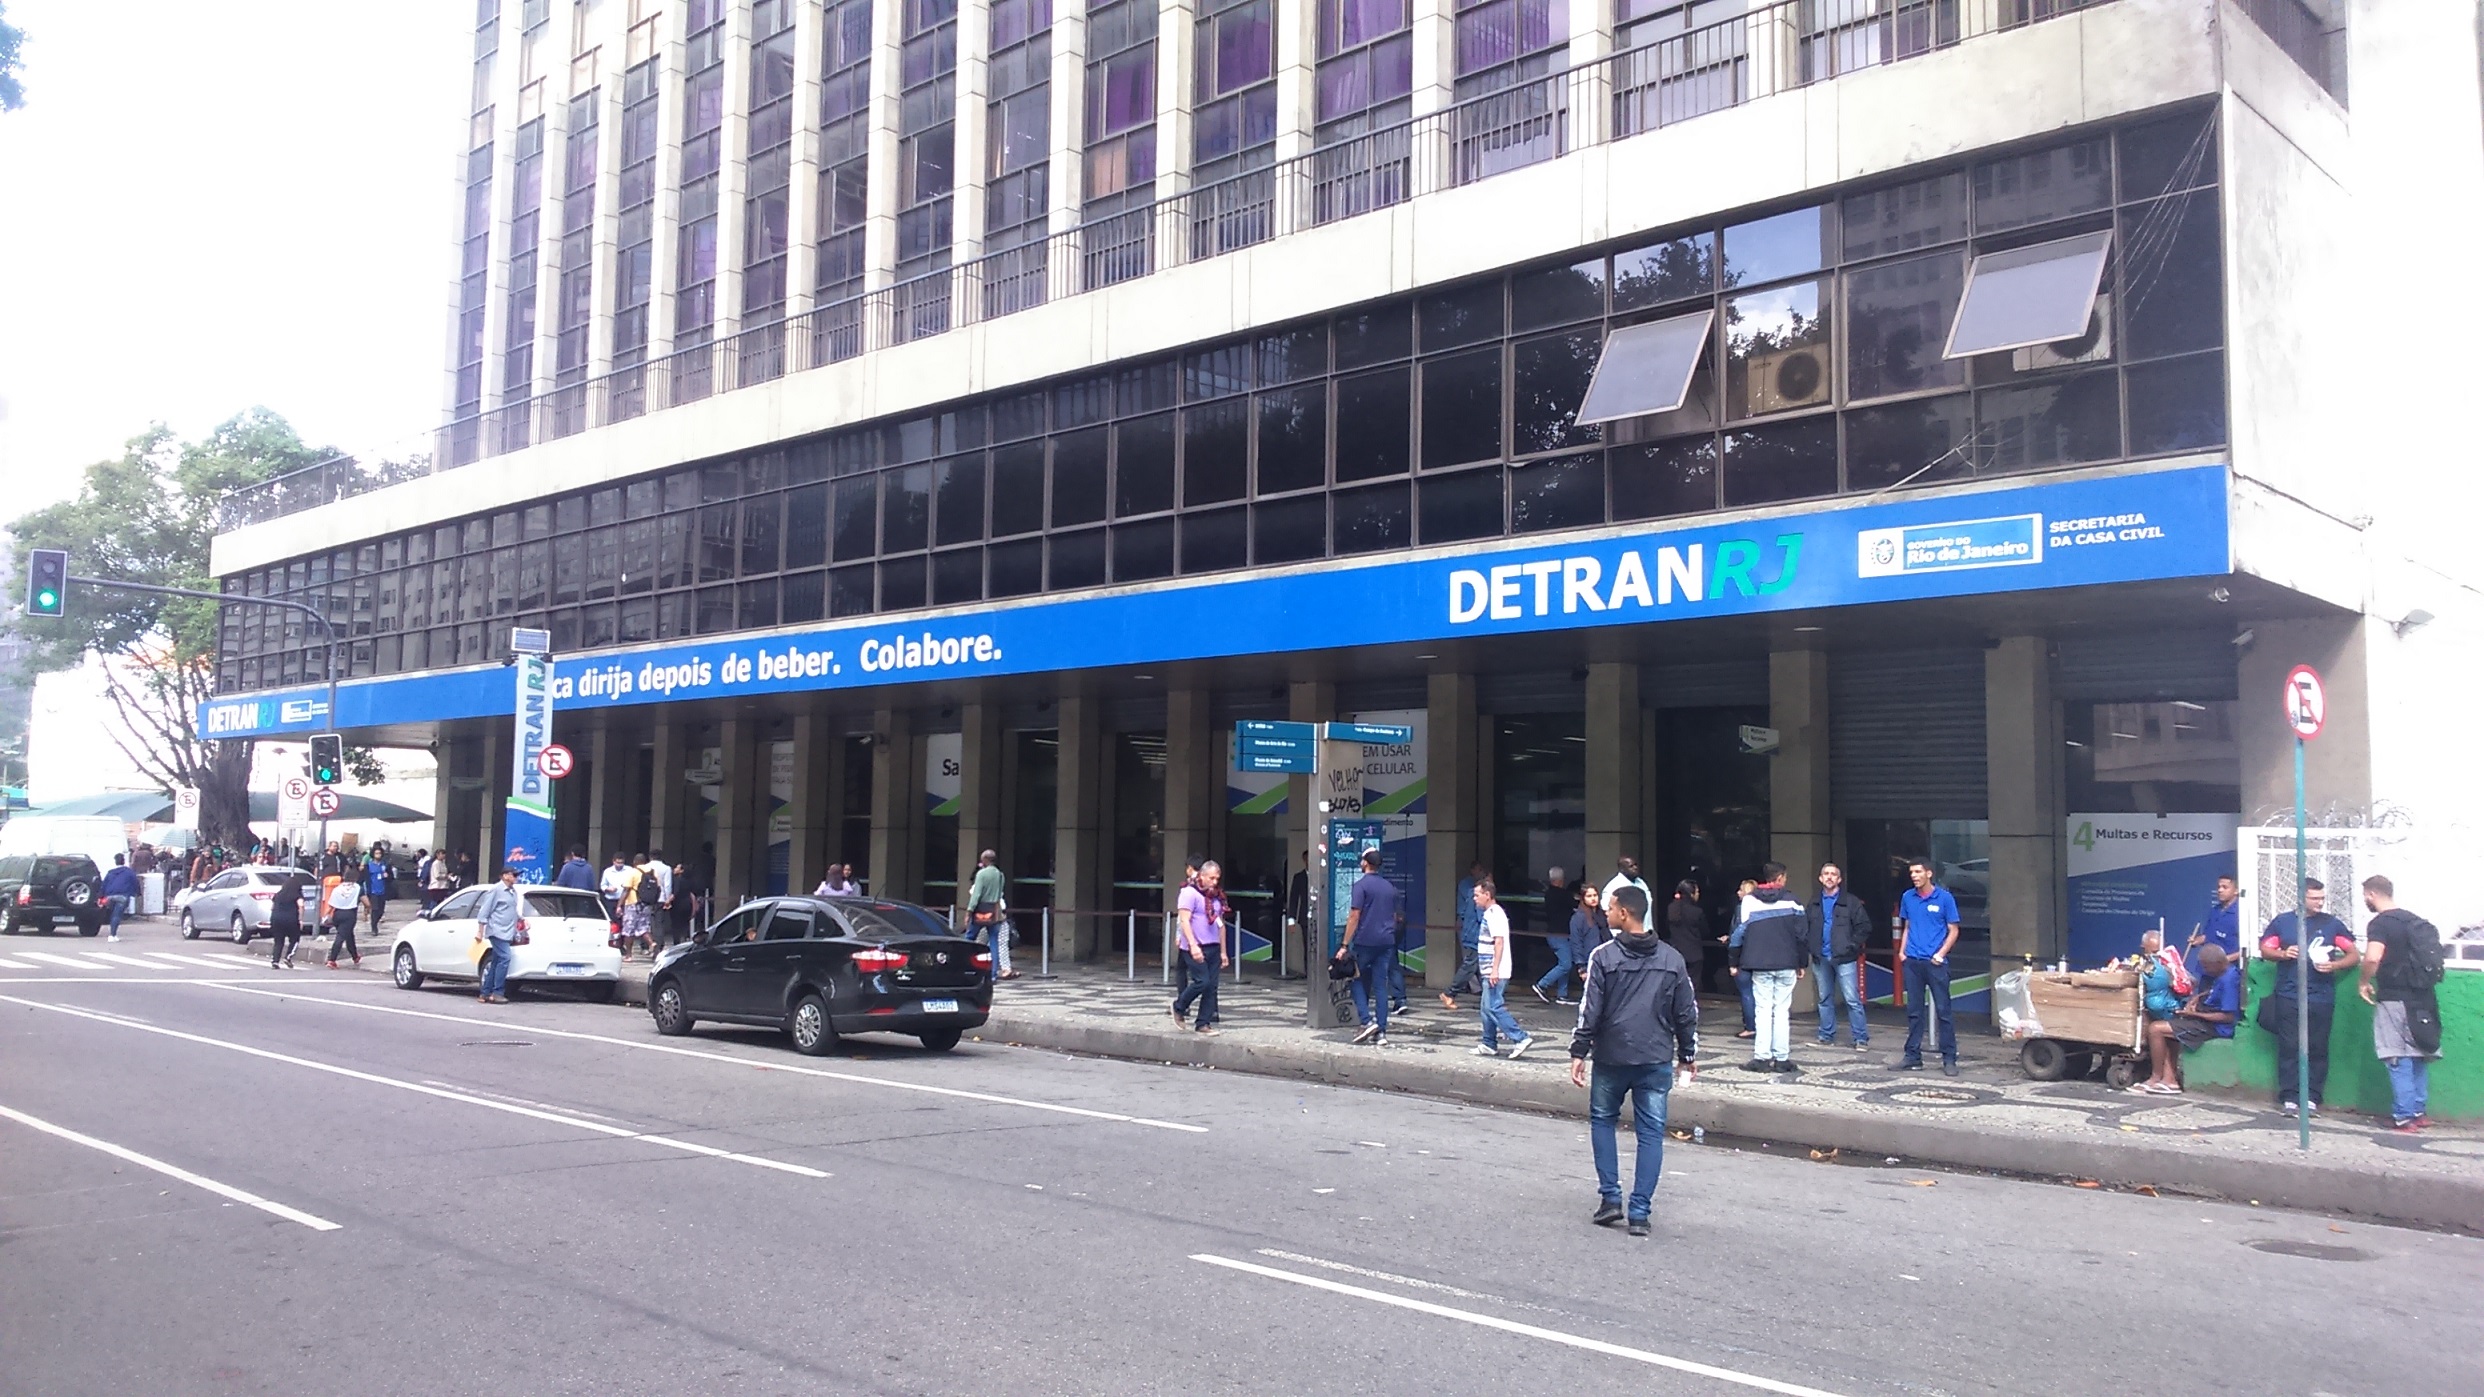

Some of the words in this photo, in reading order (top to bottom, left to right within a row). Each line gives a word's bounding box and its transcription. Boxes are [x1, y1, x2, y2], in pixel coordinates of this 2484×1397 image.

[2050, 513, 2146, 533] SECRETARIA
[2050, 535, 2072, 548] DA
[2075, 531, 2117, 545] CASA
[2119, 526, 2165, 541] CIVIL
[1907, 548, 1935, 565] Rio
[1937, 546, 1960, 561] de
[1960, 540, 2029, 559] Janeiro
[1450, 543, 1703, 624] DETRAN
[1709, 533, 1804, 600] RJ
[527, 658, 546, 694] RJ
[578, 665, 633, 701] dirija
[638, 656, 712, 696] depois
[721, 652, 751, 684] de
[758, 646, 841, 681] beber.
[860, 632, 1002, 672] Colabore.
[207, 702, 259, 733] DETRAN
[260, 702, 276, 728] RJ
[522, 694, 545, 794] DETRAN
[1362, 745, 1379, 758] EM
[1381, 744, 1411, 757] USAR
[942, 758, 959, 776] Sa
[1366, 762, 1417, 775] CELULAR.
[2072, 821, 2095, 851] 4
[2095, 828, 2138, 840] Multas
[2141, 830, 2149, 840] e
[2153, 829, 2213, 841] Recursos
